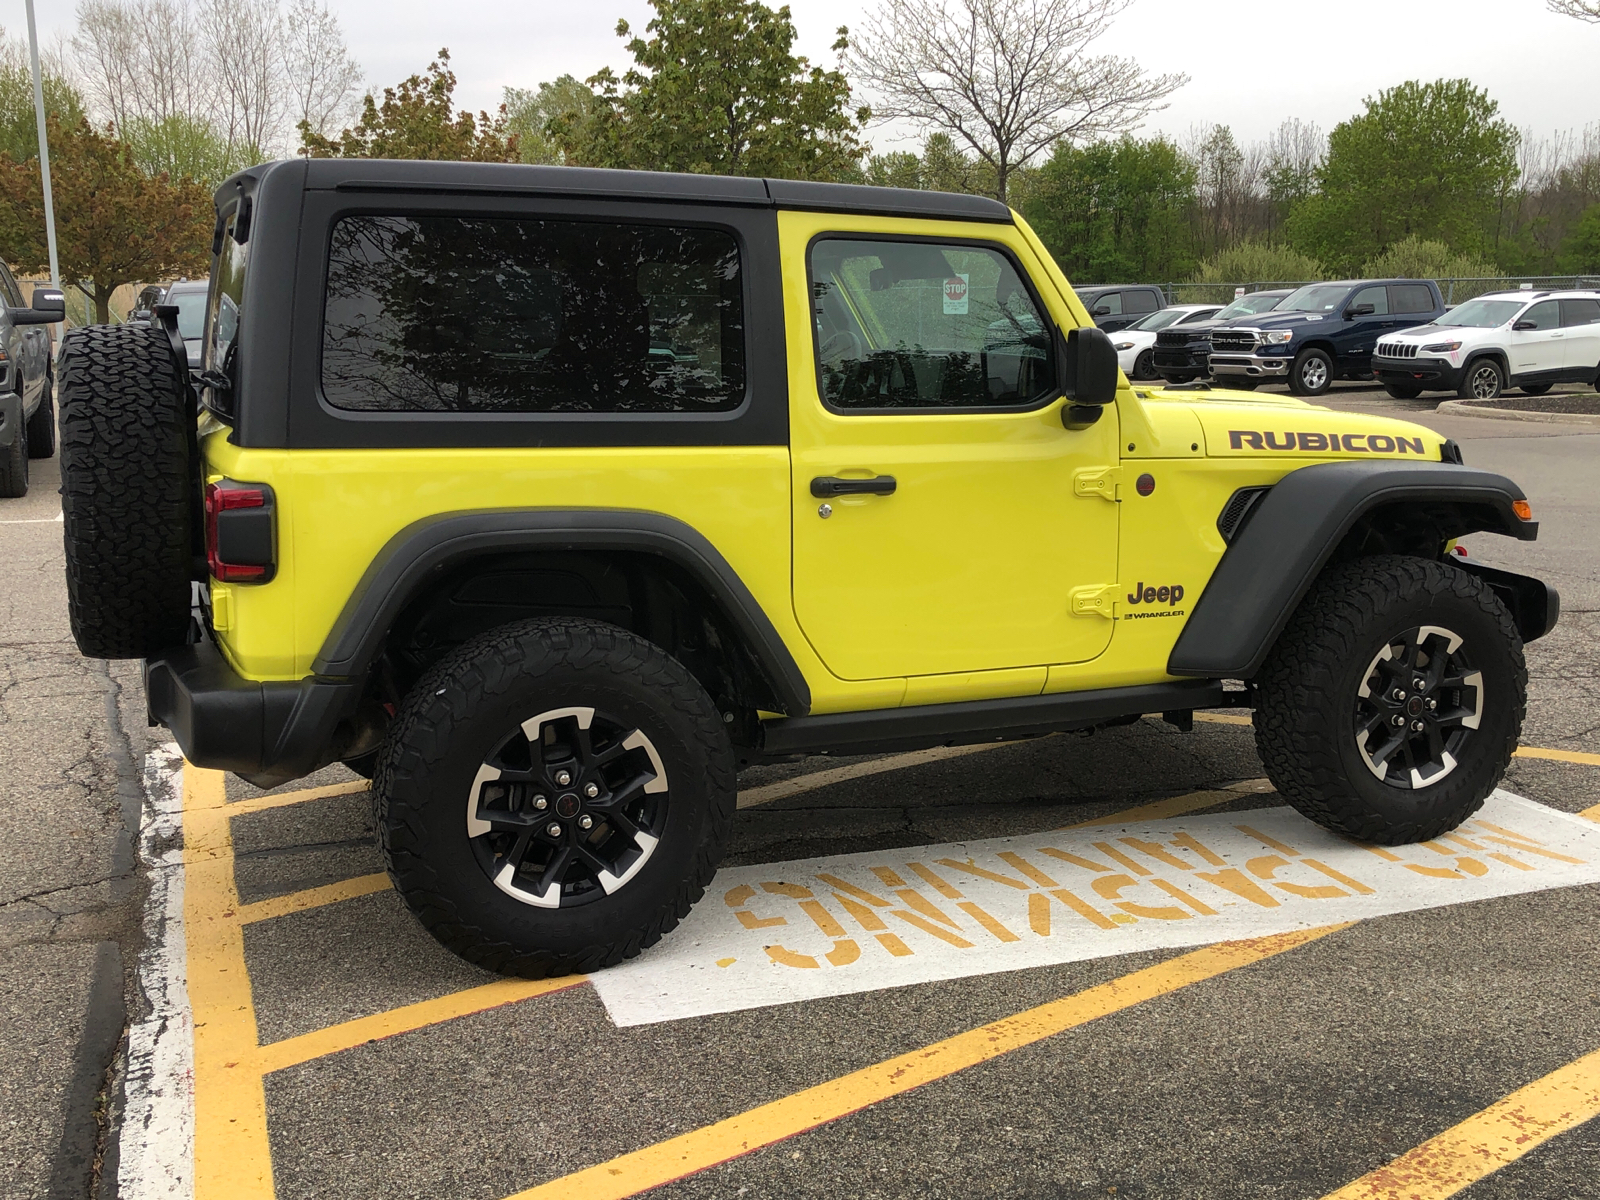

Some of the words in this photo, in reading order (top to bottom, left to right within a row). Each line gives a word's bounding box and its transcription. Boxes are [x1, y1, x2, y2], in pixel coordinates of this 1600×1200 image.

[945, 284, 966, 294] STOP
[1228, 430, 1425, 455] RUBICON
[1127, 582, 1184, 607] Jeep
[1133, 610, 1185, 619] WRANGLER
[723, 823, 1377, 969] PARKING
